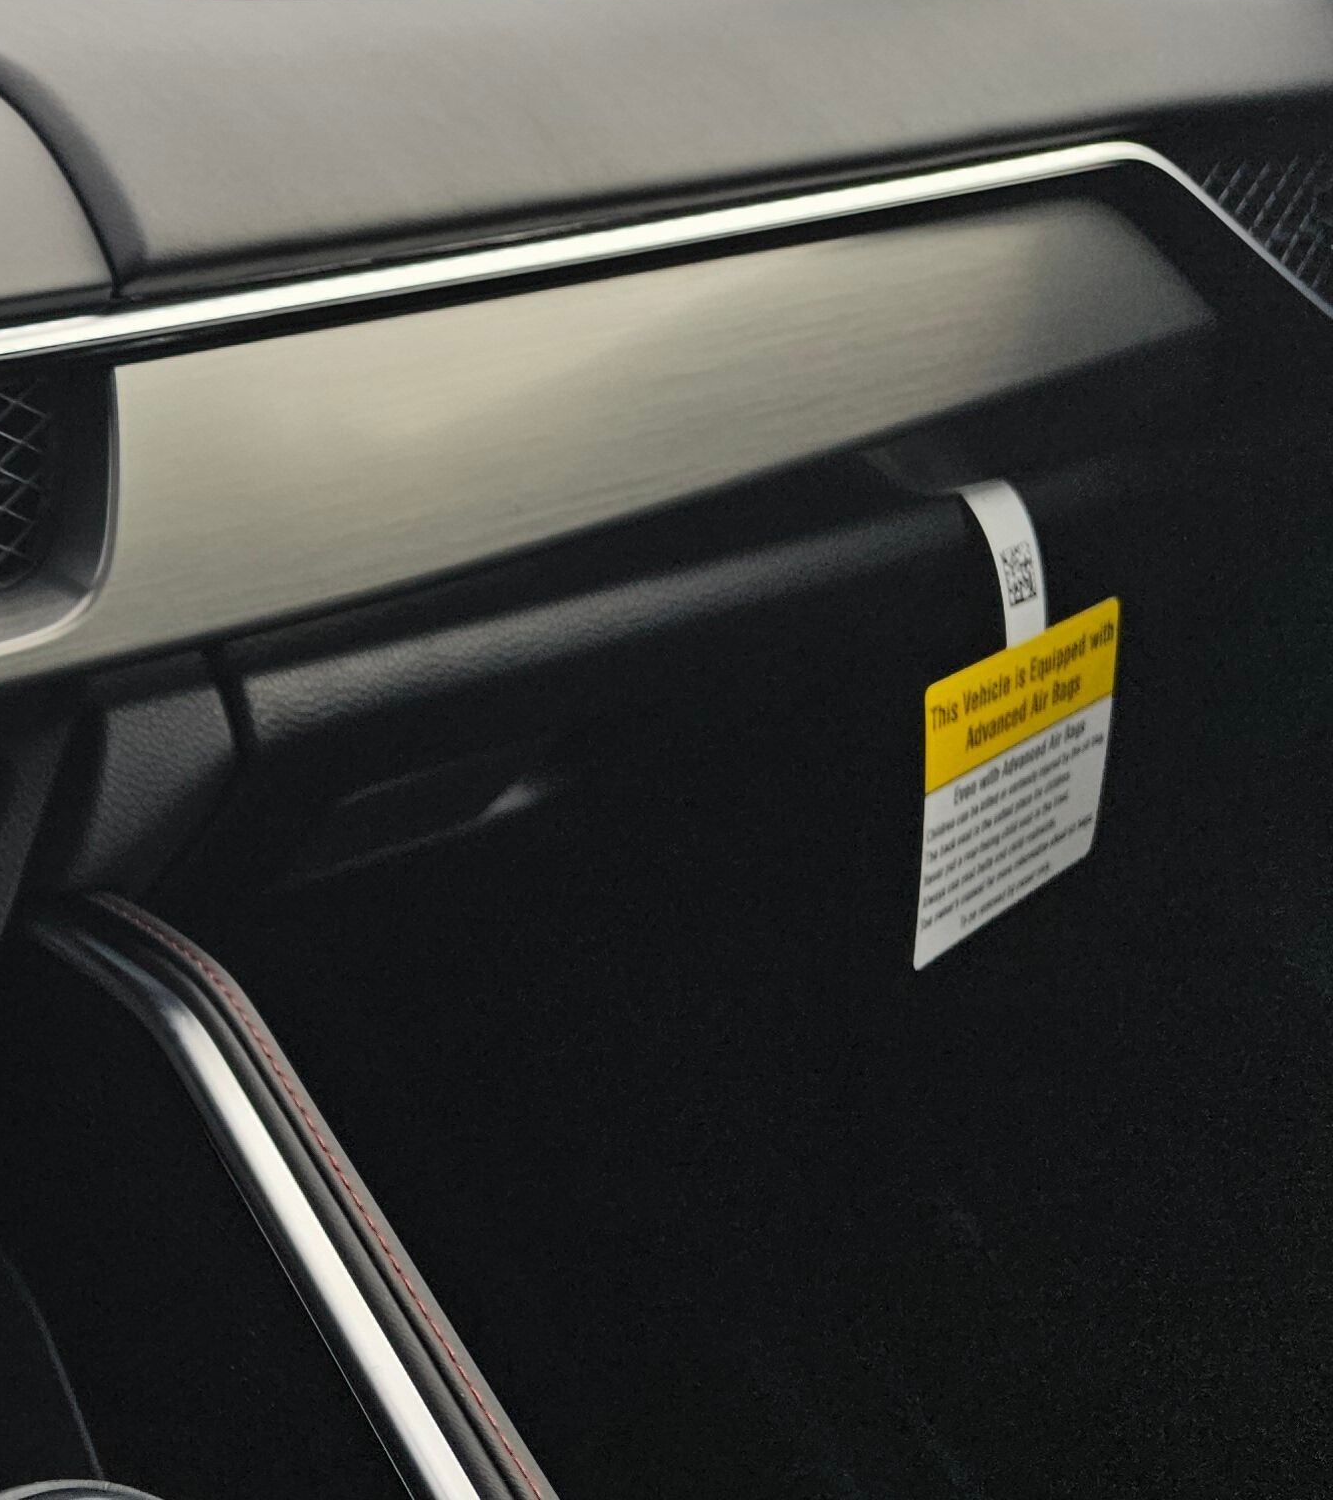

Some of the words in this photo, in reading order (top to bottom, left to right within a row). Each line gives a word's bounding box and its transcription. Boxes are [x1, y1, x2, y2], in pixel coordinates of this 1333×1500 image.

[932, 701, 958, 732] This
[962, 674, 1011, 715] Vehicle
[1015, 663, 1026, 690] is
[1030, 633, 1086, 682] Equipped
[1090, 620, 1114, 651] with
[966, 701, 1027, 751] Advanced
[1030, 690, 1048, 716] Air
[1052, 675, 1081, 706] Bags
